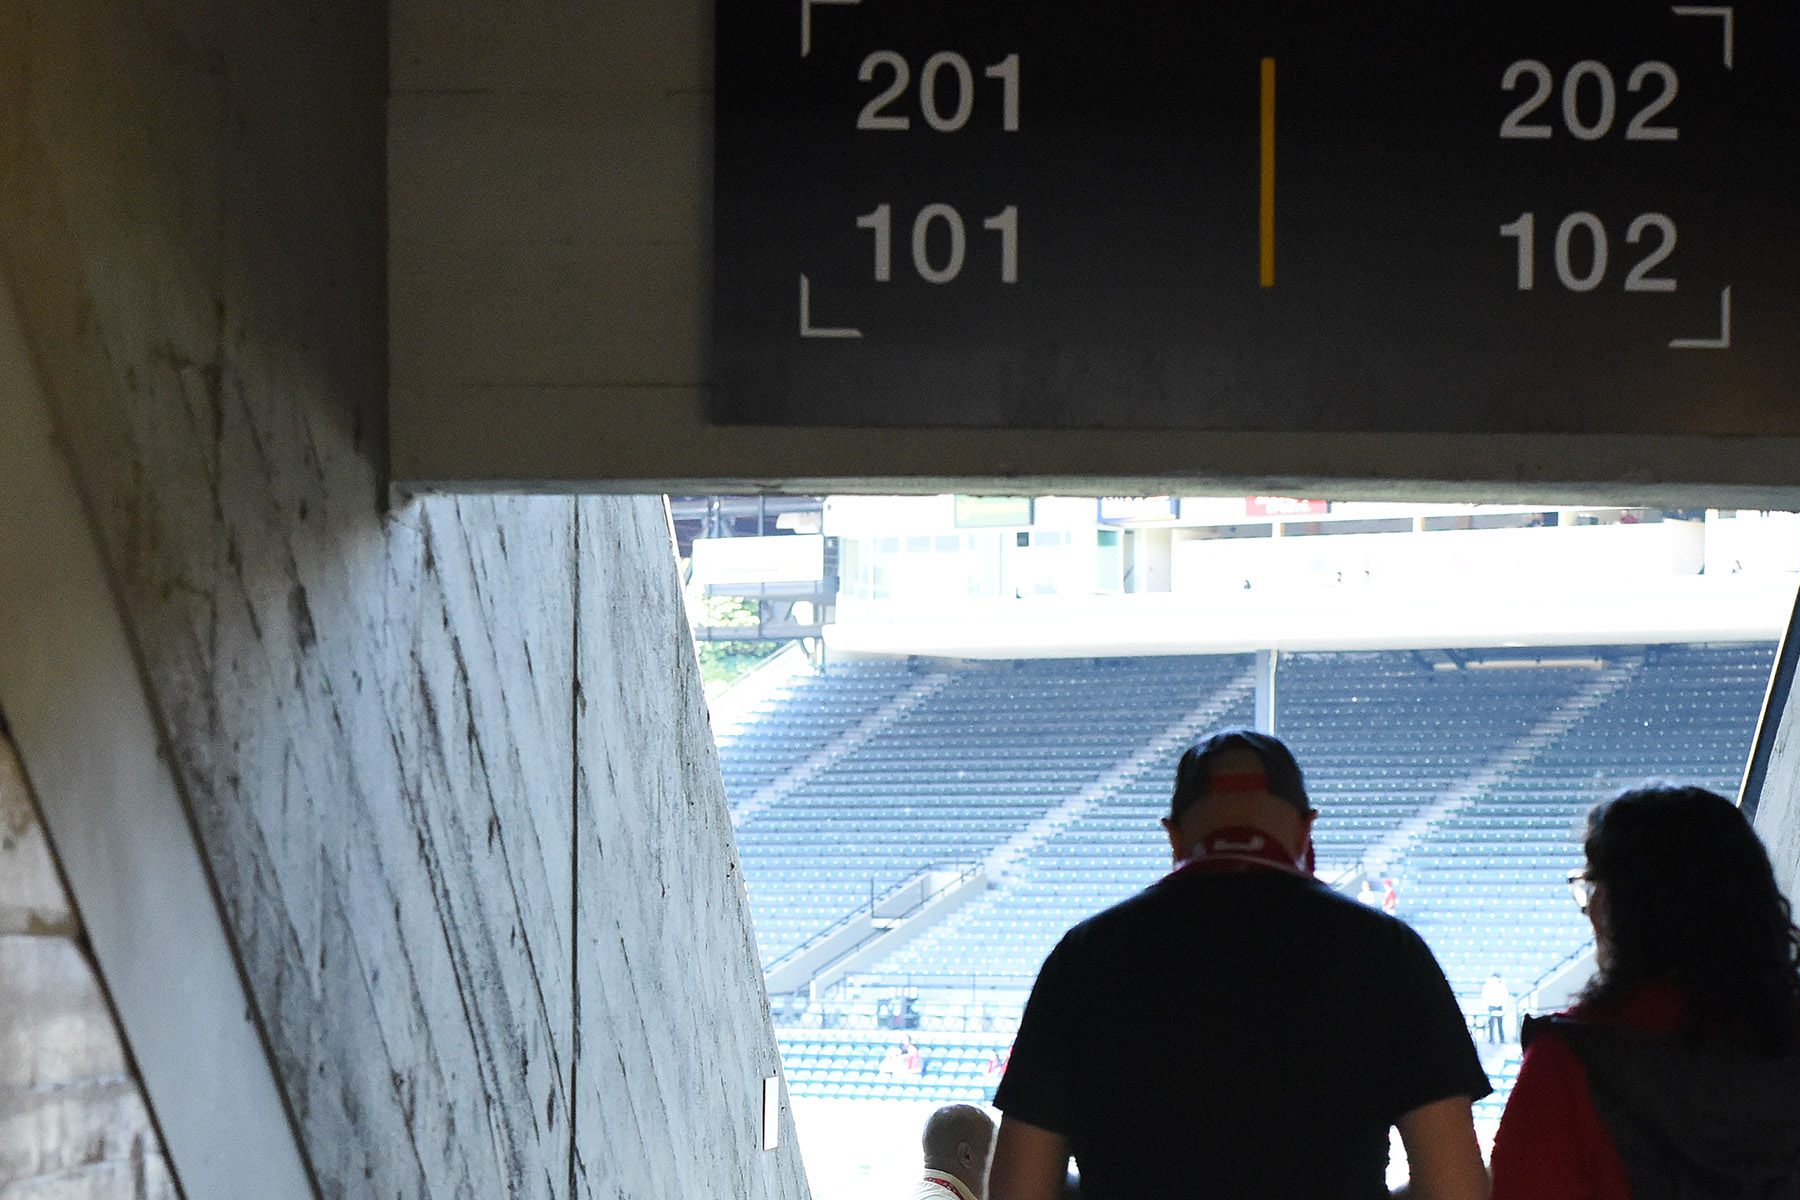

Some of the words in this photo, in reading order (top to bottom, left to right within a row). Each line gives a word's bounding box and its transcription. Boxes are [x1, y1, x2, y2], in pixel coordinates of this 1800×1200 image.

[858, 51, 1018, 131] 201
[1500, 61, 1677, 139] 202
[857, 204, 1017, 283] 101
[1501, 212, 1676, 291] 102
